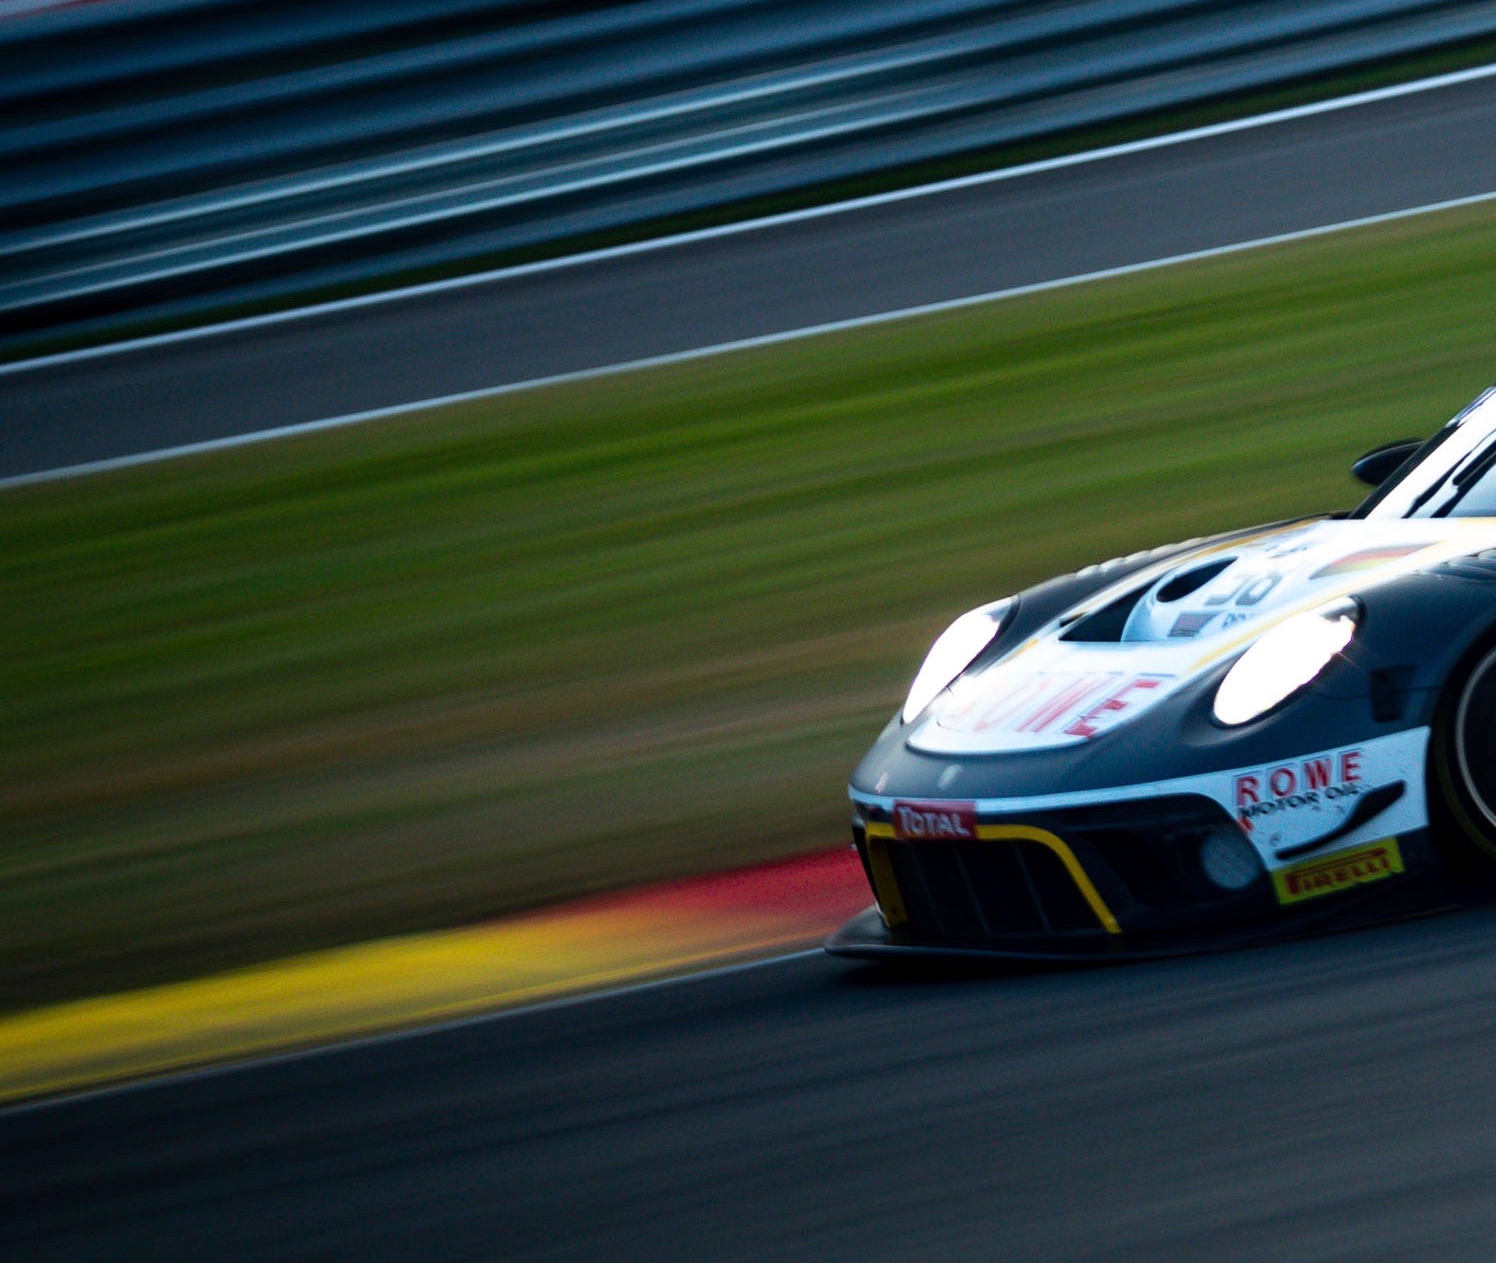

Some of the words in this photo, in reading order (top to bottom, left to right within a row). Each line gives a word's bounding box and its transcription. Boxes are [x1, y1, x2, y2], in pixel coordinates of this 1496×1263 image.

[1236, 751, 1362, 806] ROWE
[1238, 792, 1320, 819] MOTOR
[897, 806, 973, 836] TOTAL
